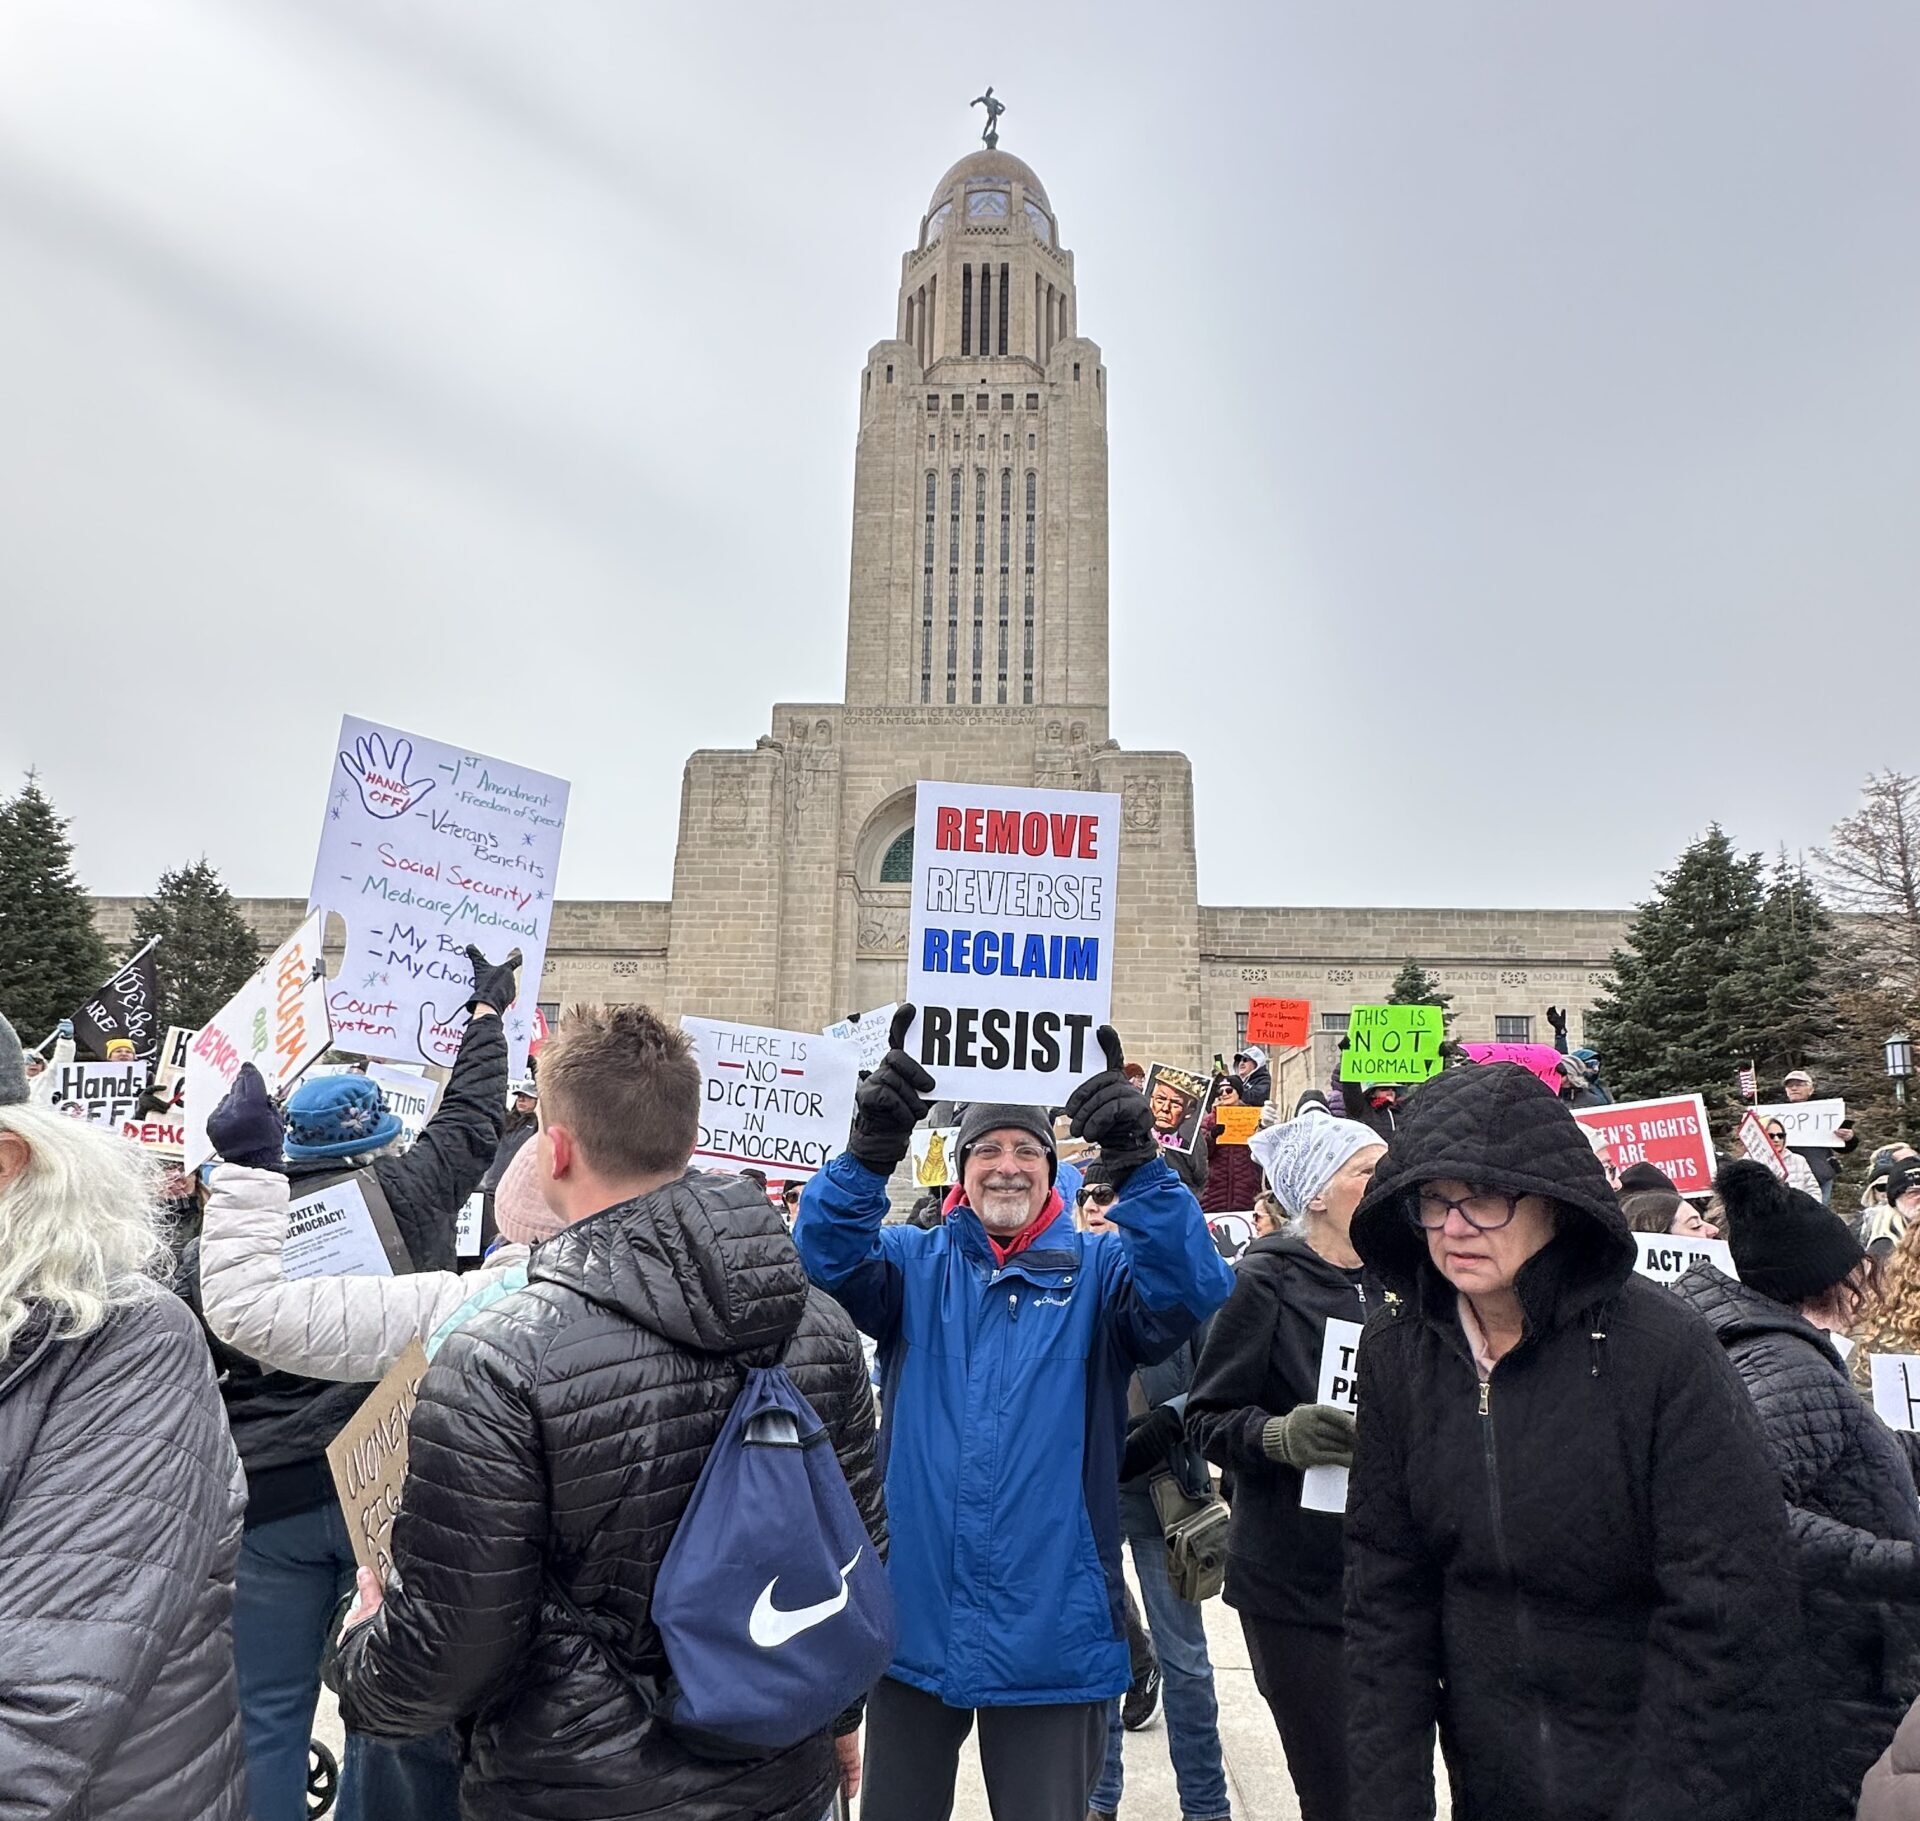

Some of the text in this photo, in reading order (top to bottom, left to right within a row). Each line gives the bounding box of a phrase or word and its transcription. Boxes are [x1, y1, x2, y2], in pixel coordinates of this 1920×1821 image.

[844, 708, 1035, 717] WISDOM JUSTICE POWER MERCY
[844, 717, 1035, 726] CONSTANT GUARDIANS OF THE LAW
[365, 771, 411, 796] HANDS
[476, 769, 552, 808] Amendment
[460, 791, 564, 828] Freedom of Speech
[935, 806, 1099, 859] REMOVE
[472, 844, 544, 879] Benefits
[378, 843, 532, 911] Social Security
[926, 867, 1102, 921] REVERSE
[388, 922, 427, 954] My
[561, 961, 608, 971] MADISON
[922, 927, 1100, 981] RECLAIM
[387, 950, 477, 989] My Choic
[1209, 968, 1585, 982] GAGE KIMBALL NEMA STANTON MORRILL
[86, 1000, 118, 1032] ARE
[330, 991, 398, 1017] Court
[1354, 1008, 1426, 1026] THIS IS
[430, 1024, 464, 1040] HAND
[831, 1015, 887, 1040] MAKING
[920, 1005, 1093, 1074] RESIST
[1255, 1029, 1291, 1040] TRUMP
[192, 1022, 240, 1083] DEMOCR
[710, 1030, 808, 1062] THERE IS
[1355, 1029, 1432, 1053] NOT
[745, 1059, 778, 1084] NO
[1351, 1058, 1434, 1077] NORMAL!
[62, 1065, 142, 1100] Hands
[384, 1090, 426, 1116] TTING
[707, 1078, 825, 1118] DICTATOR
[743, 1112, 765, 1133] IN
[1599, 1116, 1699, 1145] EN'S RIGHTS
[1815, 1113, 1840, 1130] IT
[695, 1125, 833, 1167] DEMOCRACY
[1618, 1142, 1649, 1164] ARE
[1650, 1157, 1698, 1179] GHTS
[289, 1200, 327, 1224] PATE IN
[1646, 1248, 1683, 1273] ACT
